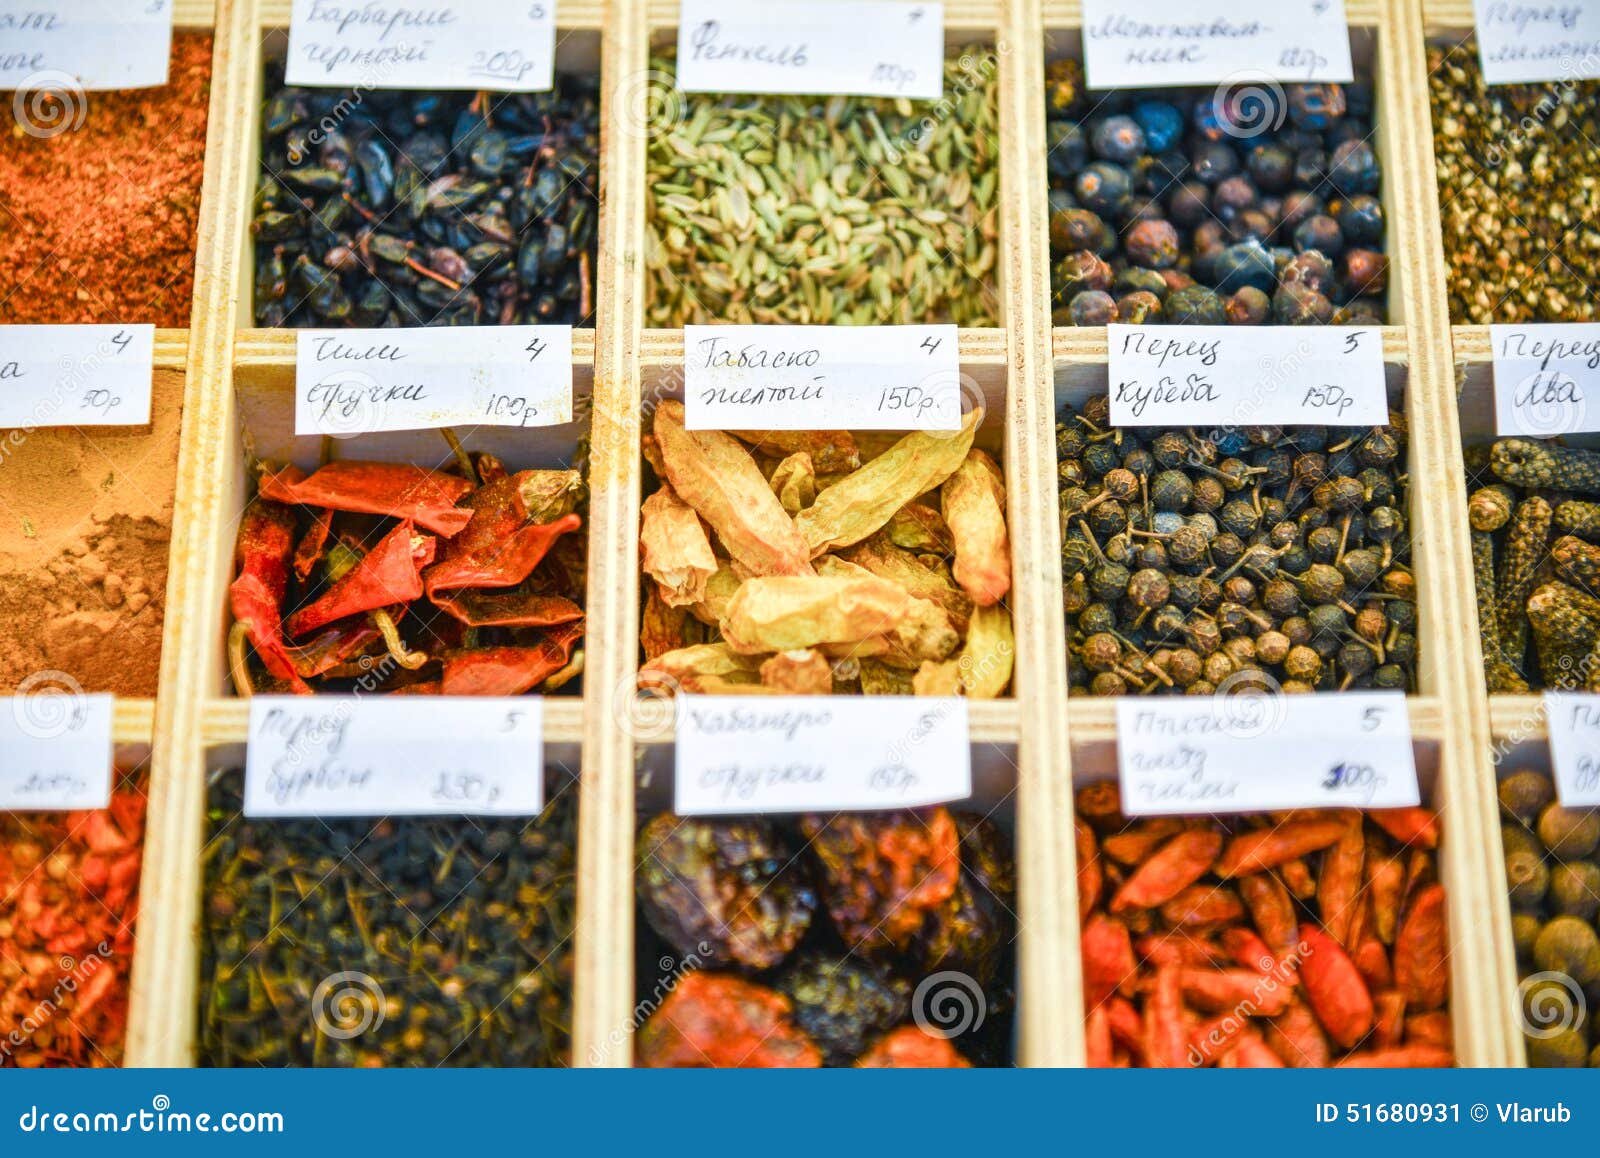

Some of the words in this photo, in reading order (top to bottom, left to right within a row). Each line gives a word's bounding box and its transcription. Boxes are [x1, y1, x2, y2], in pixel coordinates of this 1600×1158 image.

[112, 330, 133, 354] 4
[312, 336, 409, 361] Чили
[525, 337, 547, 362] 4
[698, 337, 820, 369] Табаско
[919, 336, 942, 354] 4
[1122, 332, 1222, 368] Перец
[1342, 331, 1368, 354] 5
[1361, 706, 1387, 732] 5
